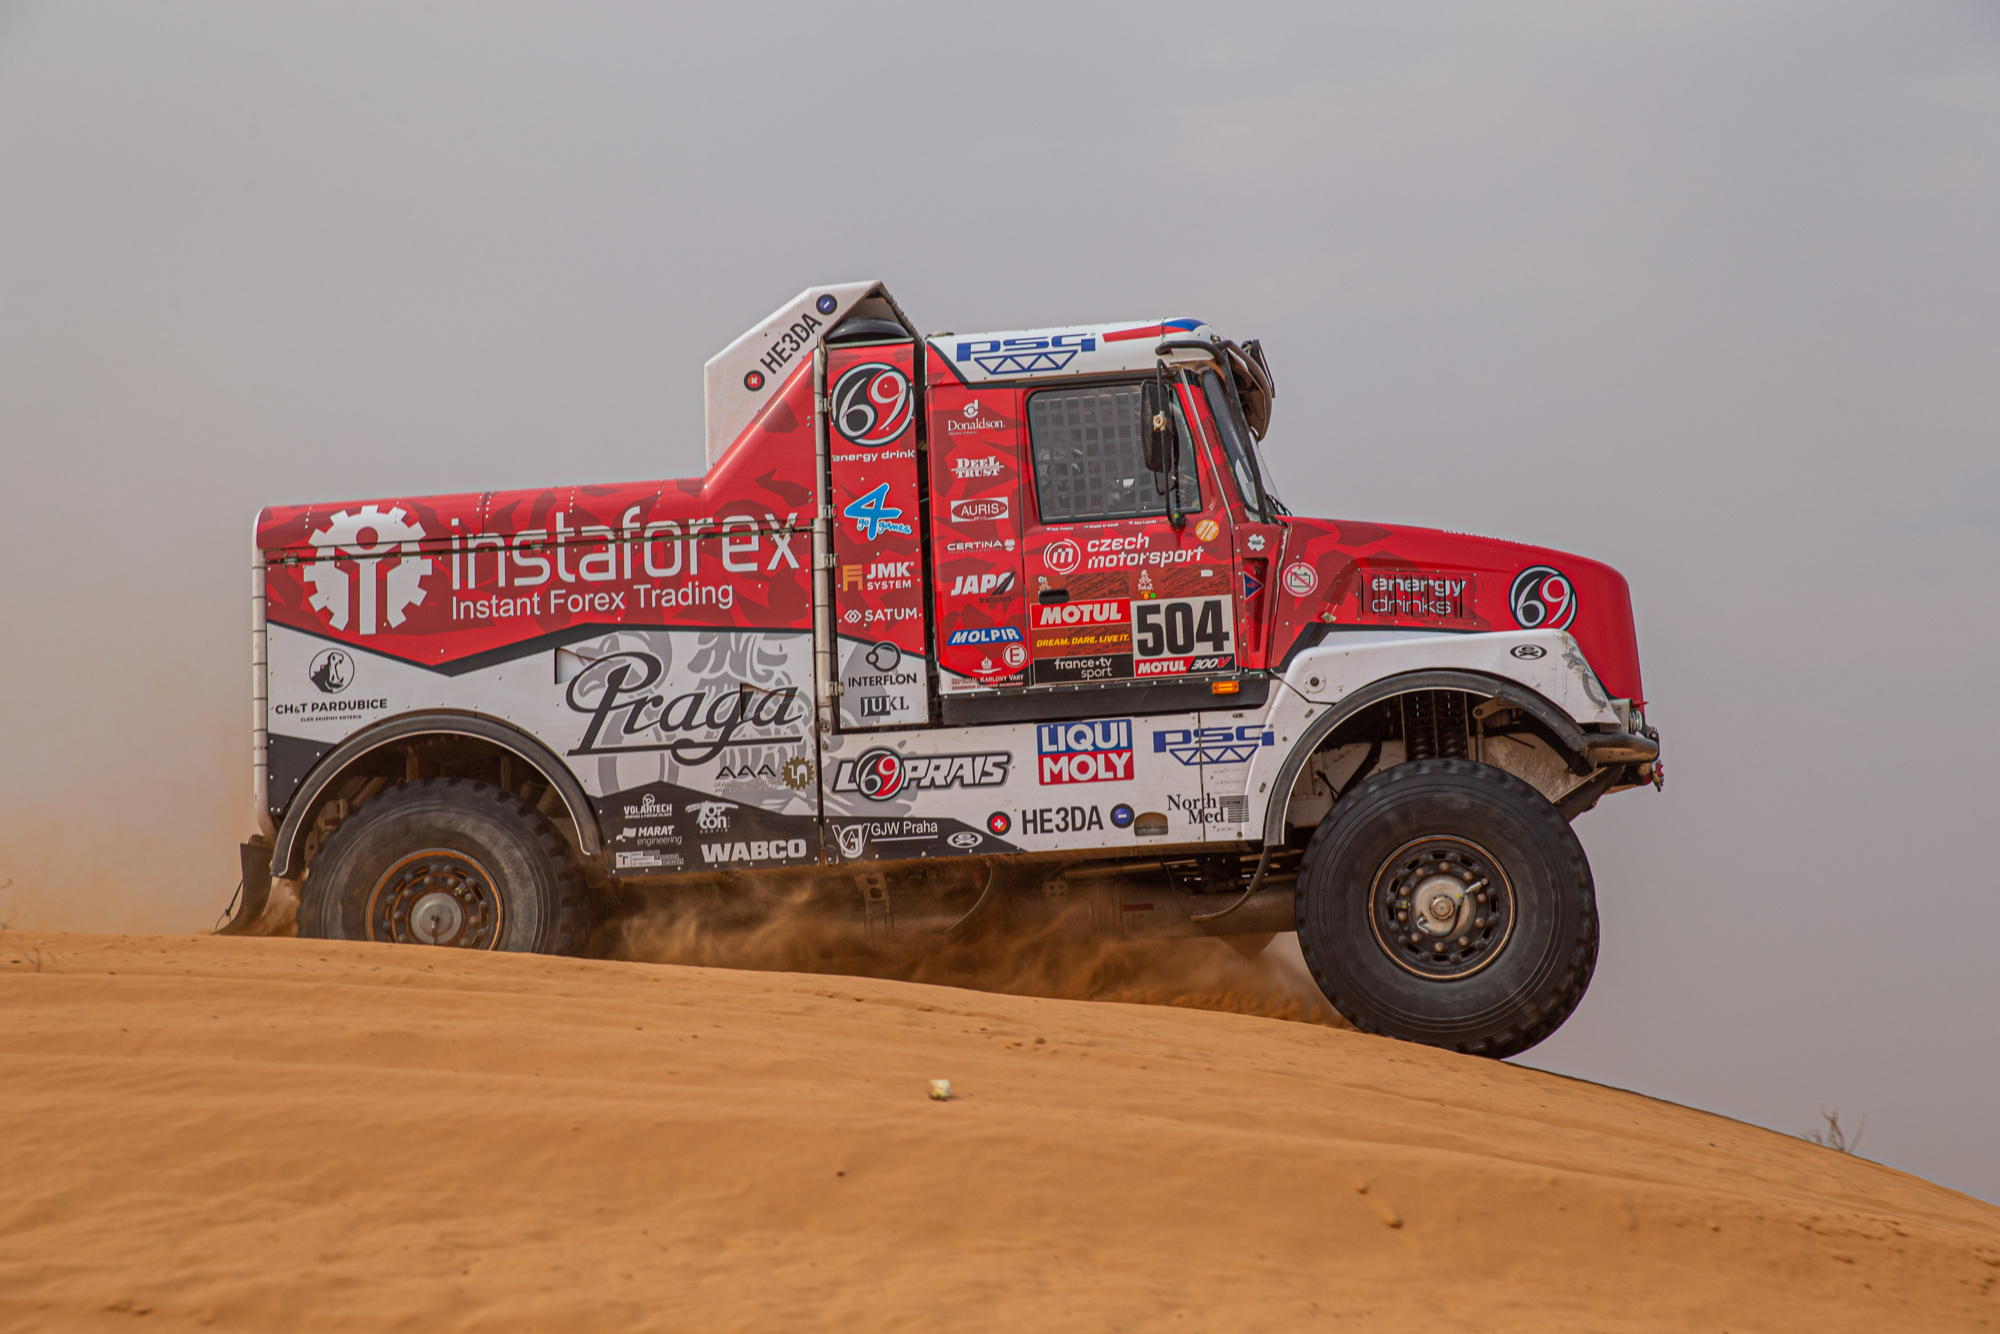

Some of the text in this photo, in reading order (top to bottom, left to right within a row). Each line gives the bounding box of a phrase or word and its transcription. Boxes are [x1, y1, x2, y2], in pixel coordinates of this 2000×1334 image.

[760, 313, 823, 374] HE3DA
[832, 452, 878, 463] energy
[956, 468, 1000, 479] TRUST
[961, 503, 999, 517] AURIS
[451, 506, 800, 590] instaforex
[947, 540, 1003, 551] CERTINA
[1087, 532, 1150, 552] czech
[1087, 546, 1204, 569] motorsport
[866, 562, 911, 579] JMK
[867, 579, 912, 591] SYSTEM
[1371, 576, 1467, 598] energy
[451, 581, 734, 621] Instant Forex Trading
[1371, 597, 1452, 615] drinks
[864, 607, 918, 622] SATUM
[1040, 602, 1122, 625] MOTUL
[951, 628, 1021, 644] MOLPIR
[1136, 600, 1230, 657] 504
[1036, 637, 1070, 647] DREAM.
[1072, 635, 1097, 645] DARE.
[1099, 634, 1118, 644] LIVE
[1081, 666, 1112, 681] sport
[1138, 656, 1231, 674] MOTUL 300V
[848, 672, 917, 688] INTERFLON
[311, 698, 388, 713] PARDUBICE
[565, 651, 803, 766] Praga
[1041, 721, 1128, 752] LIQUI
[1042, 751, 1132, 783] MOLY
[1167, 793, 1217, 811] North
[1022, 805, 1104, 835] HE3DA
[1188, 806, 1225, 825] Med
[638, 825, 675, 837] MARAT
[871, 821, 938, 837] GJW Praha
[637, 836, 682, 848] engineering
[701, 839, 807, 863] WABCO
